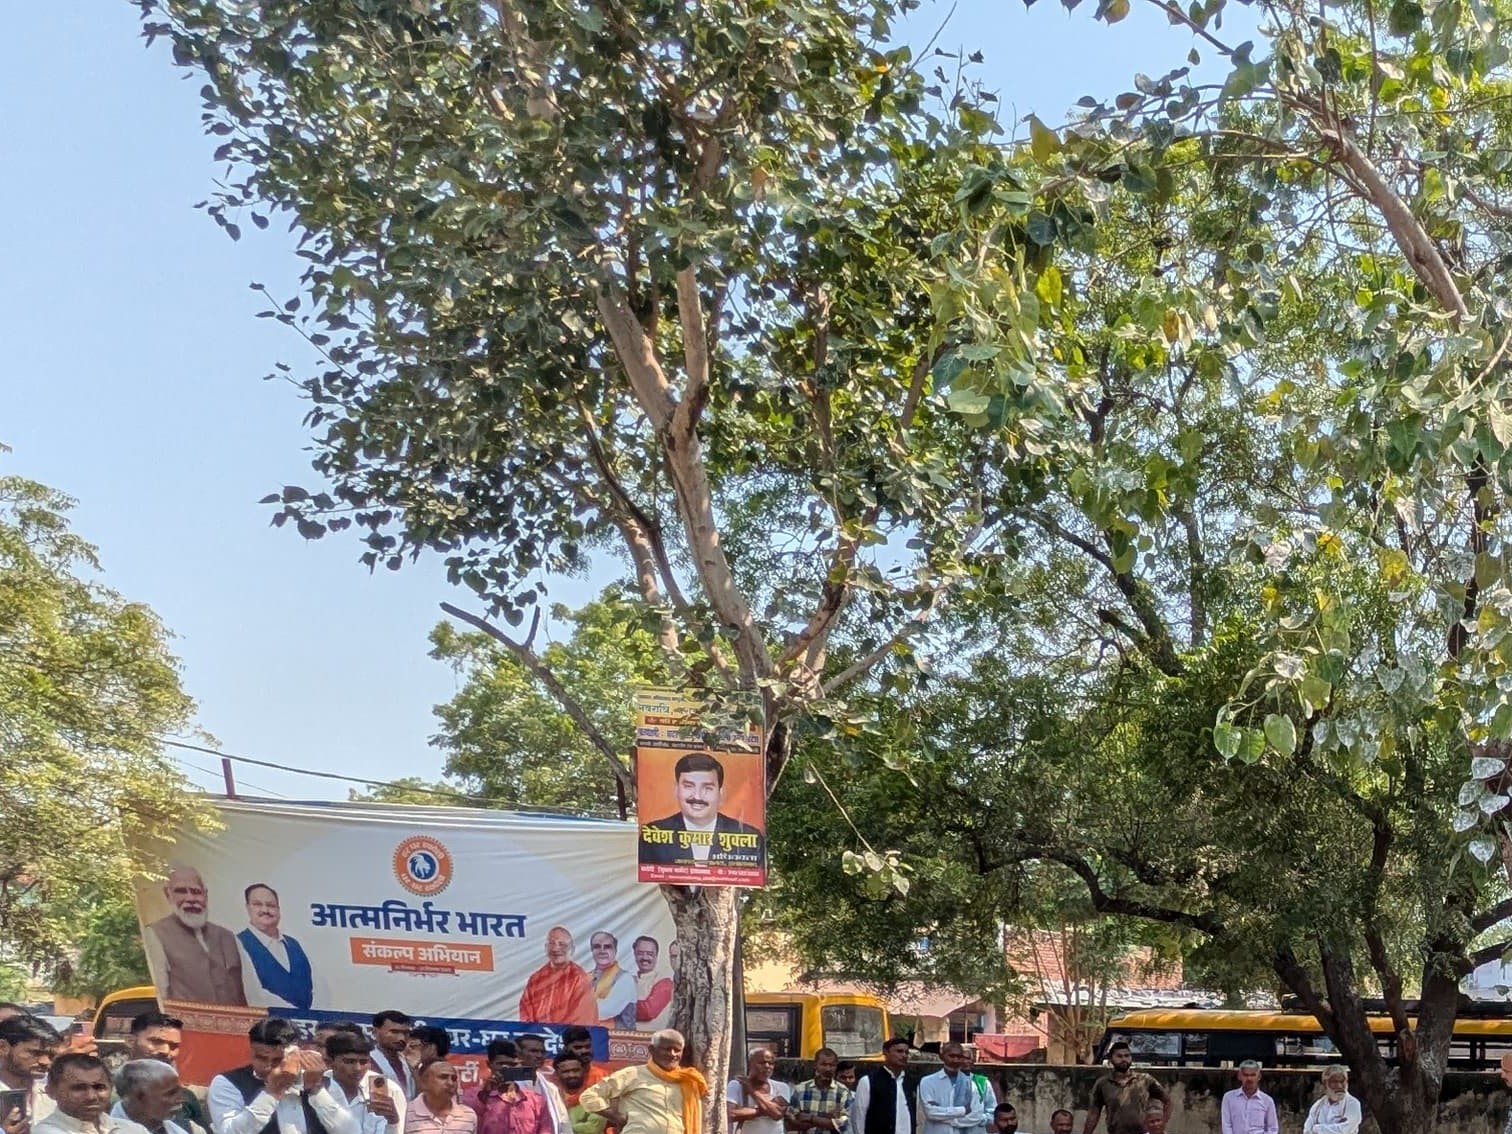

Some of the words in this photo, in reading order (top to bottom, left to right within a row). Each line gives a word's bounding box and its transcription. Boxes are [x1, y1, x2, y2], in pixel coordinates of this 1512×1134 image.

[642, 825, 674, 845] देवेश
[678, 829, 714, 850] कुमार
[718, 832, 758, 852] शुक्ला
[310, 900, 451, 934] आत्मनिर्भर
[456, 911, 528, 938] भारत
[361, 941, 414, 961] संकल्प
[418, 945, 481, 965] अभियान
